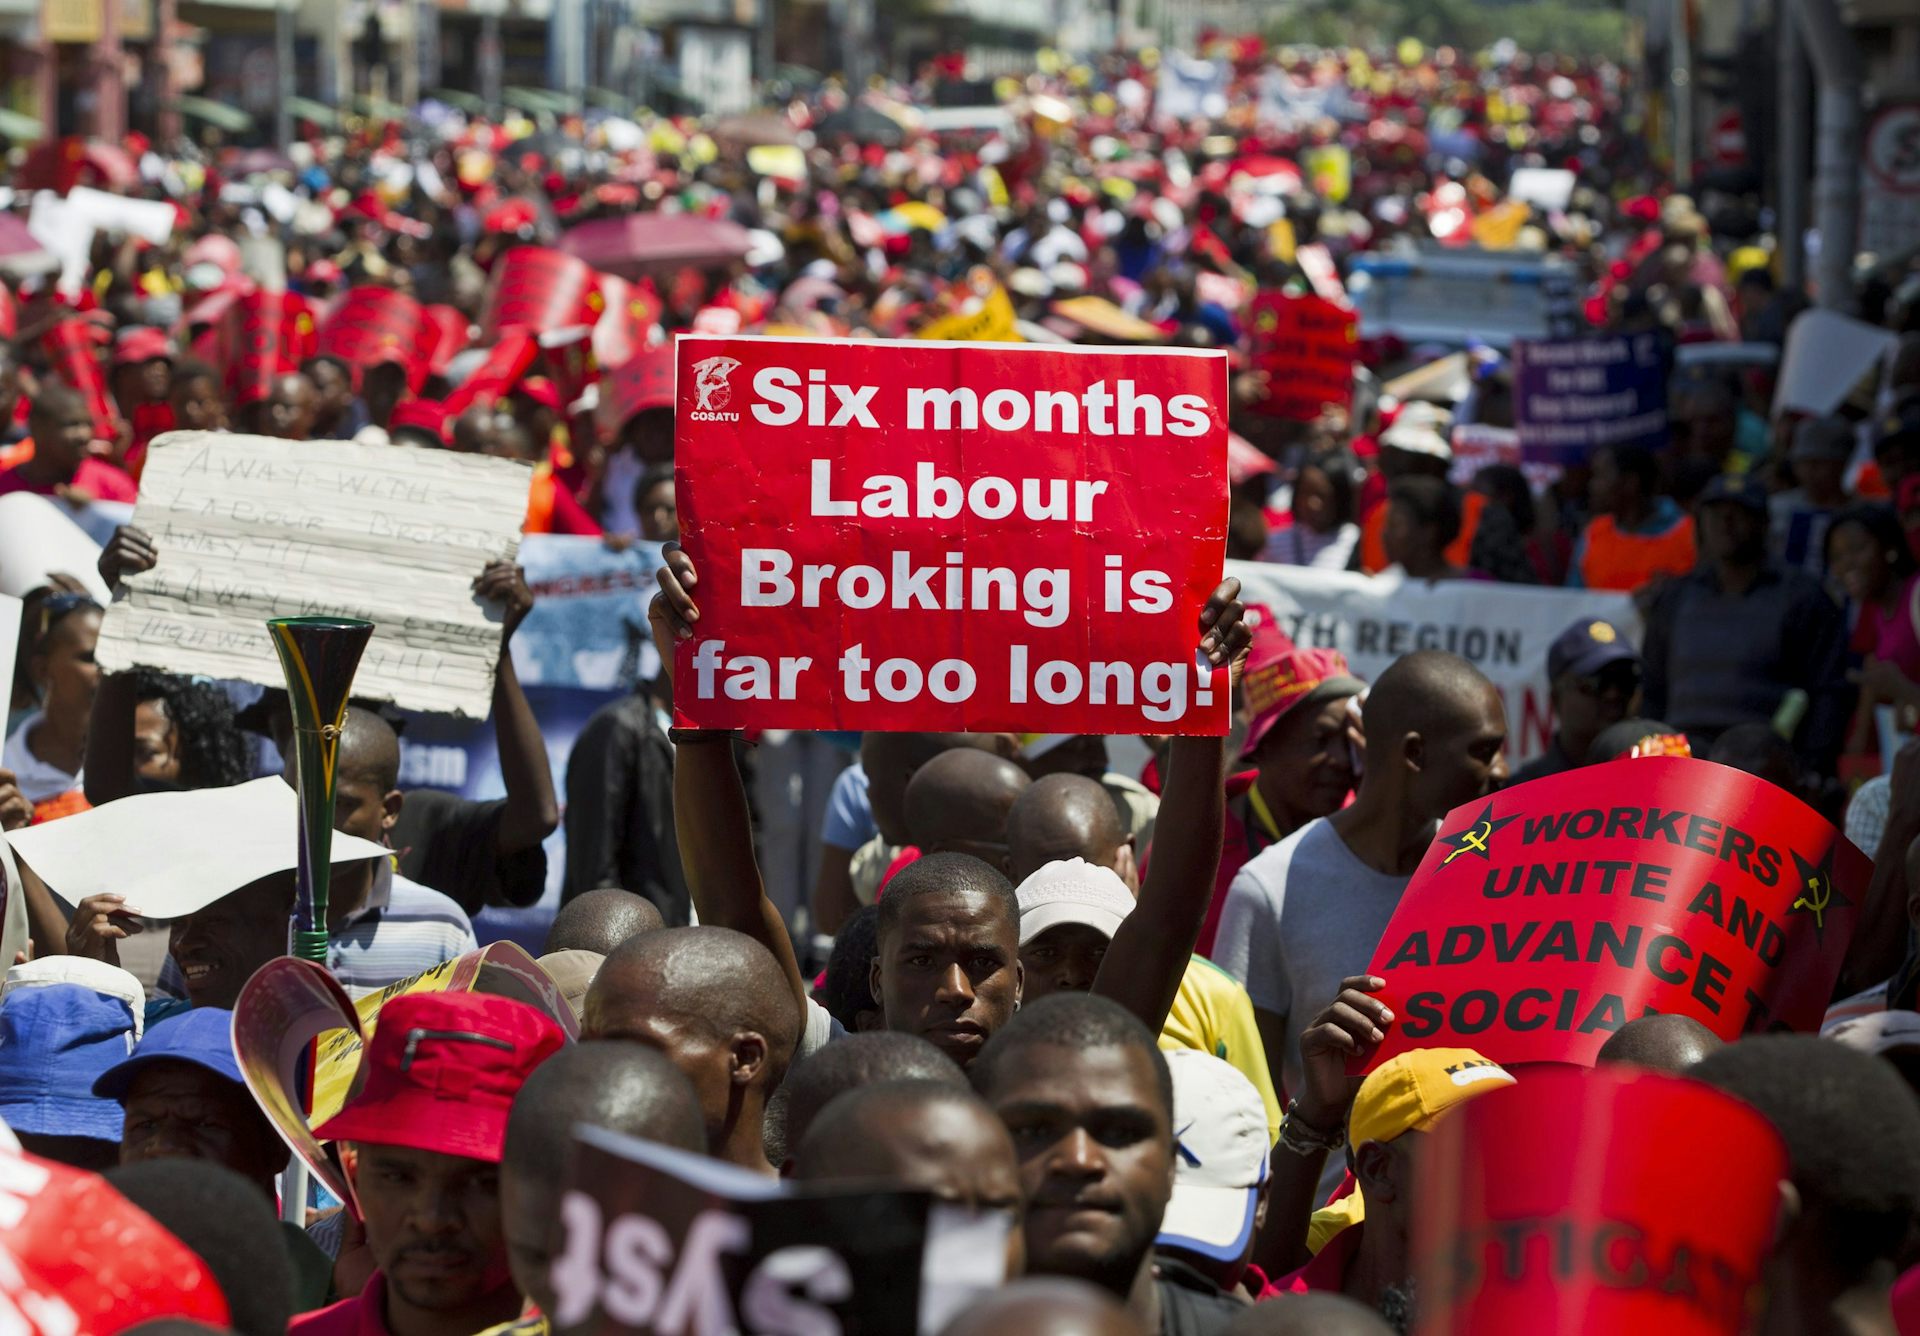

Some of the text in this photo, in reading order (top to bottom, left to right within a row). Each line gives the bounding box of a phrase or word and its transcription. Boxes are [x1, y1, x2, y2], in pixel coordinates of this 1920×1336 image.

[690, 411, 740, 422] COSATU
[751, 366, 1212, 438] Six months
[810, 458, 1110, 523] Labour
[740, 547, 1174, 629] Broking is
[1357, 618, 1523, 665] REGION
[691, 639, 813, 702] far
[839, 643, 977, 704] too
[1009, 645, 1215, 723] long!
[1521, 806, 1784, 888] WORKERS
[1482, 860, 1786, 969] UNITE AND
[1383, 920, 1733, 1016] ADVANCE
[1402, 987, 1659, 1039] SOCIA
